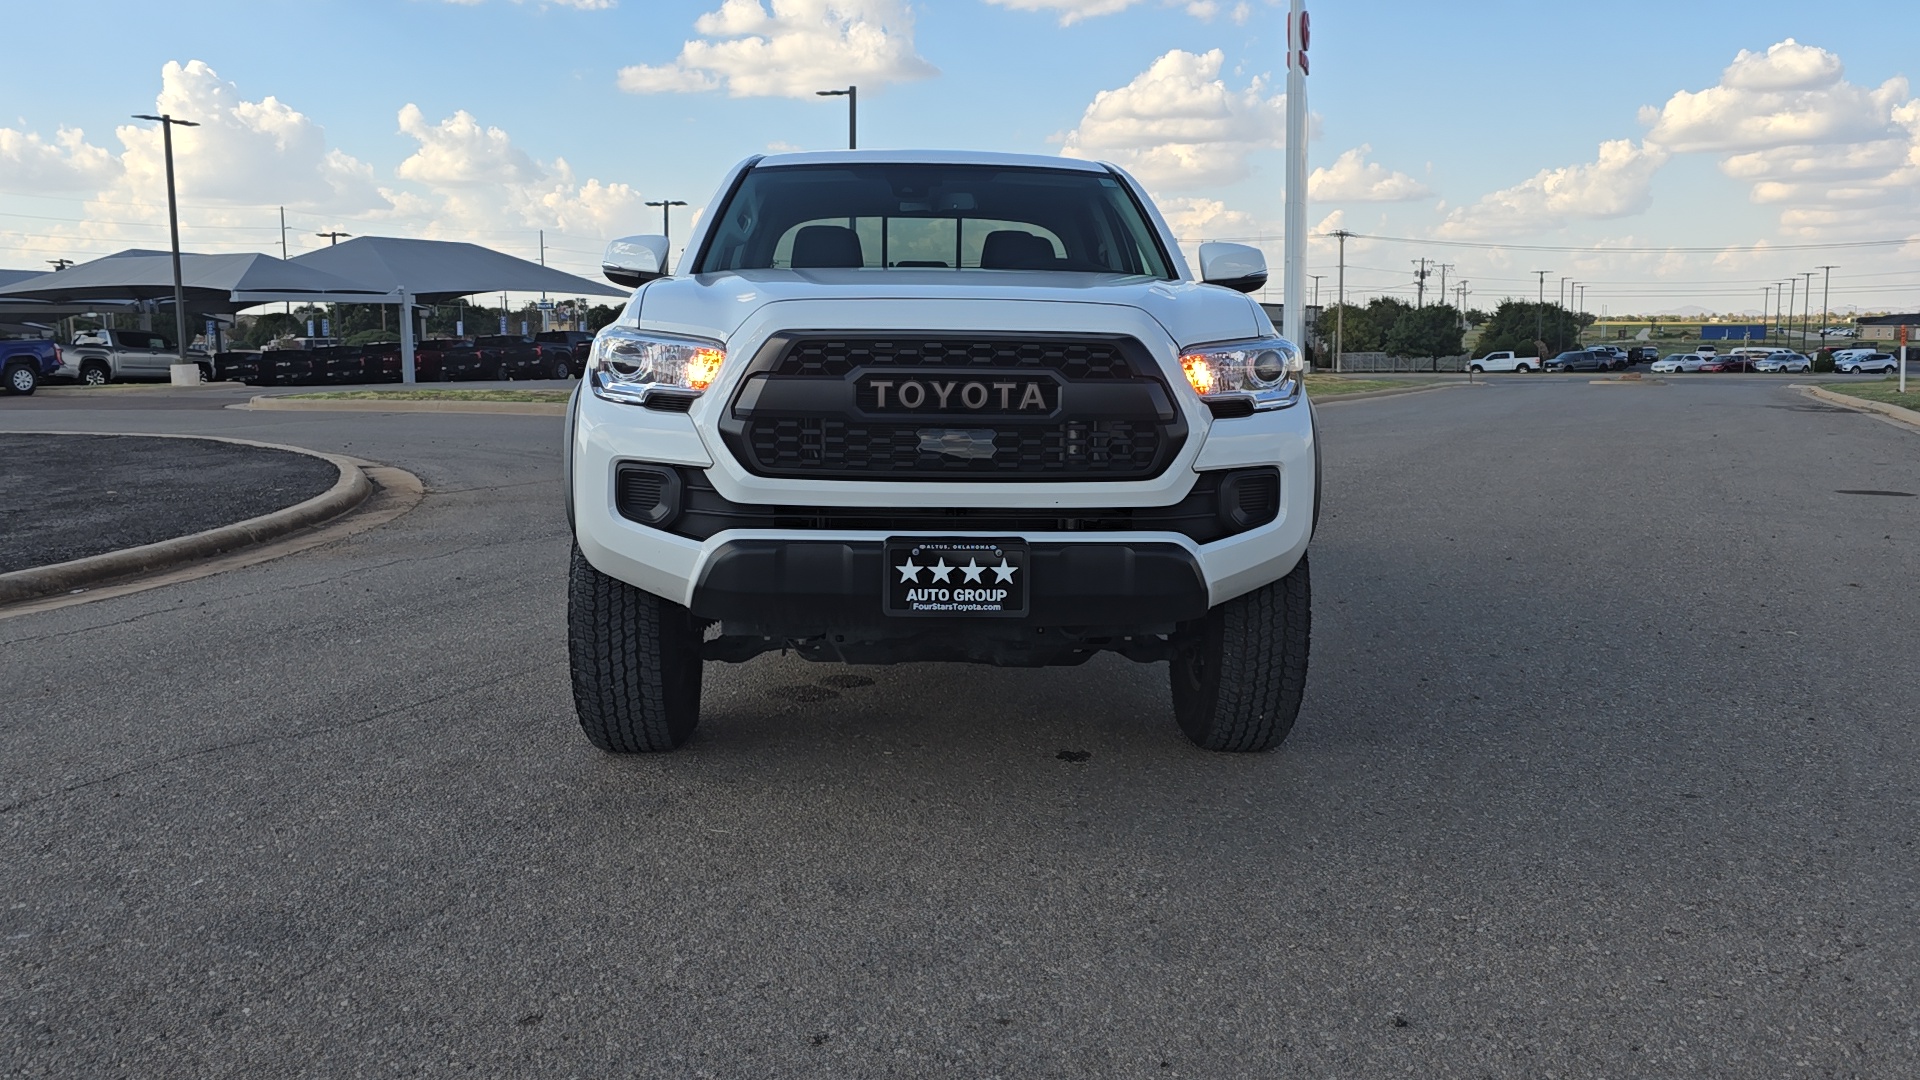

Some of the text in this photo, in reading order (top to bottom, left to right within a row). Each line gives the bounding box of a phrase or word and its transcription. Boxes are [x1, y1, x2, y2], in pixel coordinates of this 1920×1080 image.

[870, 380, 1047, 410] TOYOTA
[906, 588, 1008, 602] AUTO GROUP
[912, 602, 1002, 612] FourStarsToyota.com
